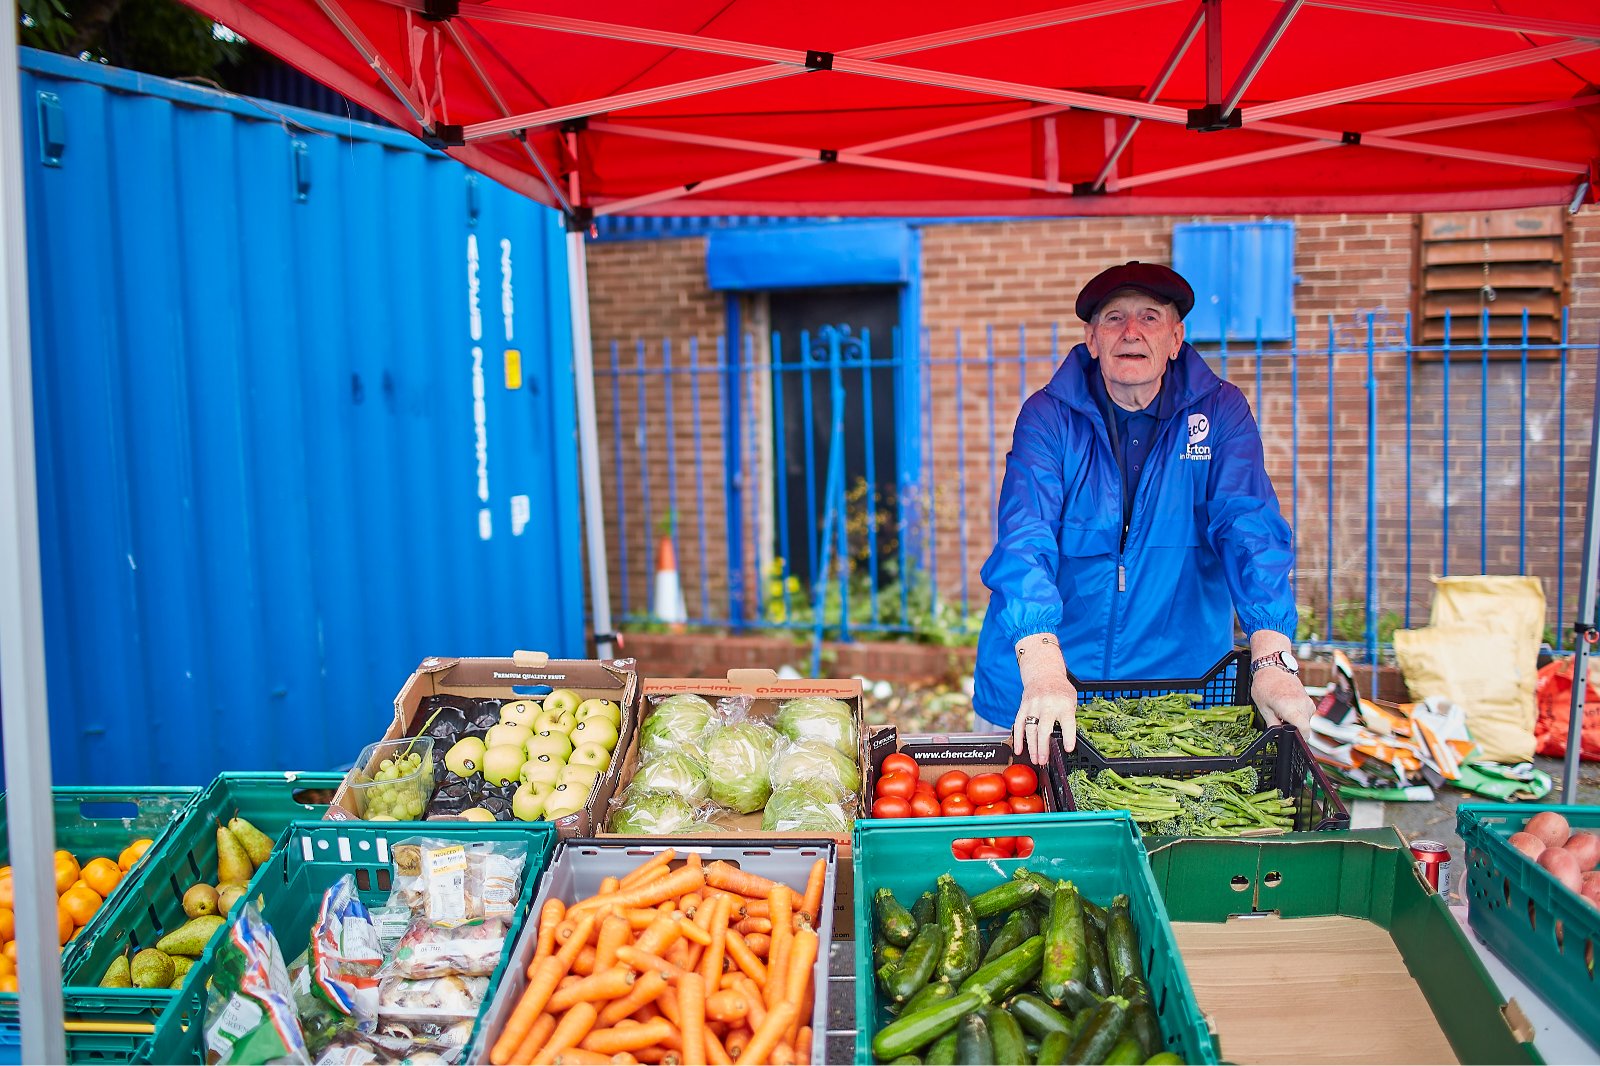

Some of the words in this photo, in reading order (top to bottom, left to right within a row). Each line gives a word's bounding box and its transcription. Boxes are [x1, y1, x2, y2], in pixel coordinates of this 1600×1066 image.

[1188, 419, 1207, 436] itC
[1186, 444, 1211, 454] Erton
[522, 673, 547, 681] QUALITY
[914, 749, 996, 760] www.chenczke.pl
